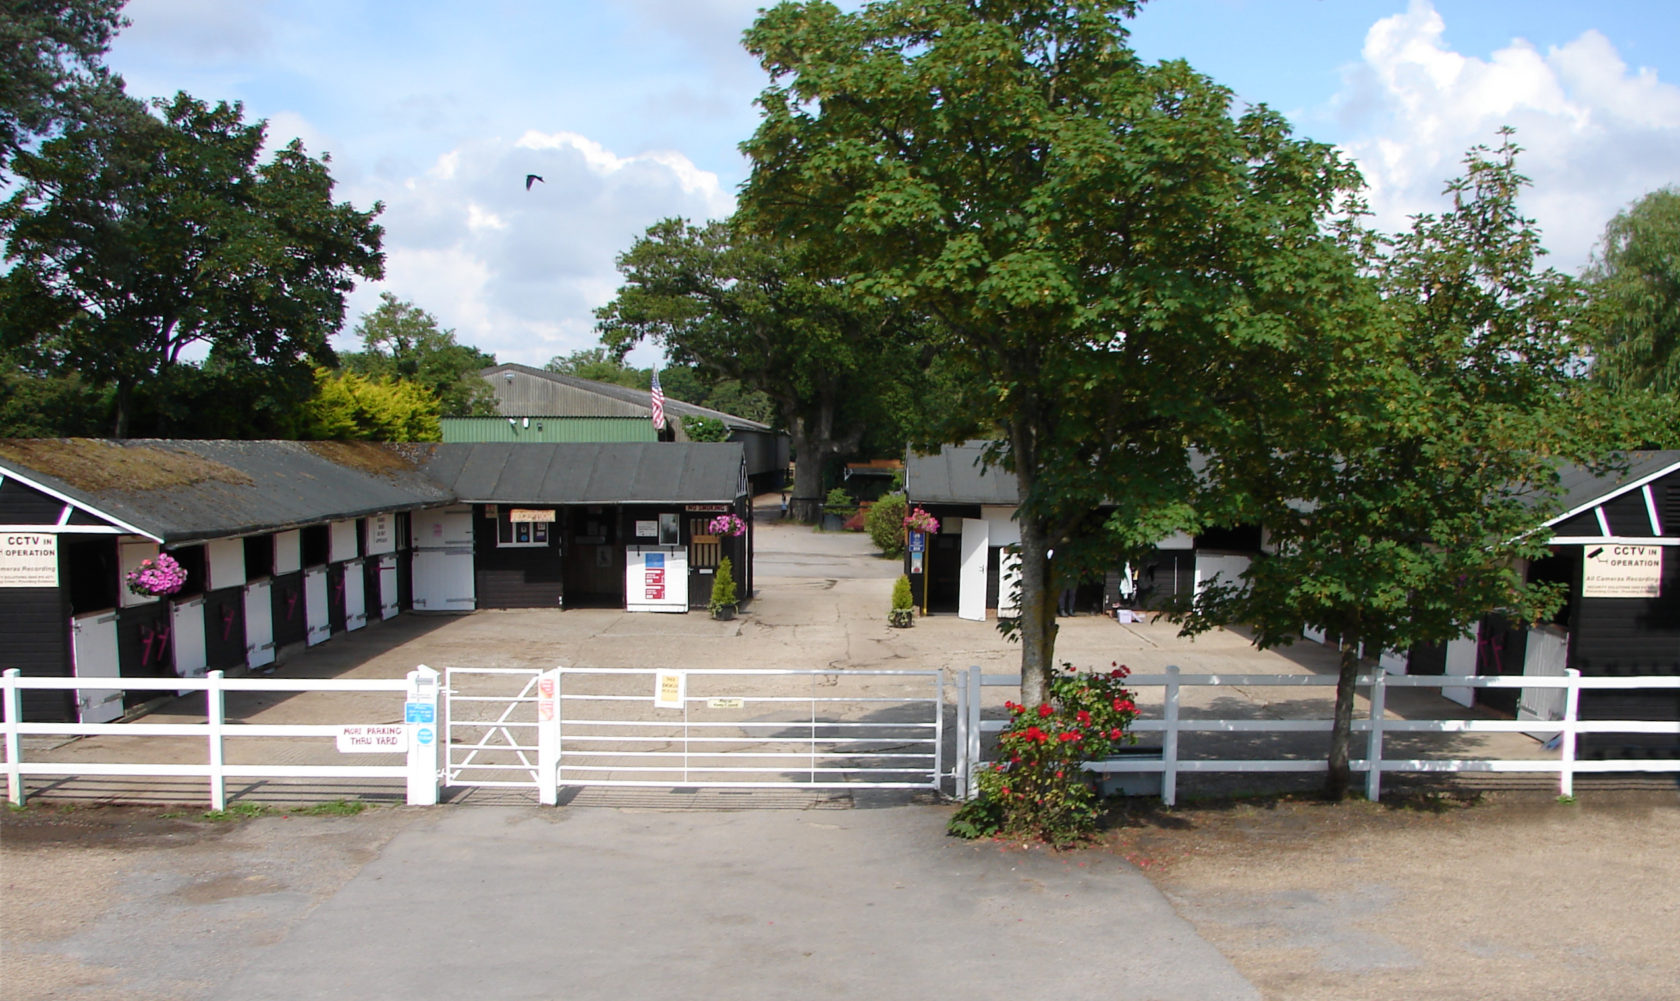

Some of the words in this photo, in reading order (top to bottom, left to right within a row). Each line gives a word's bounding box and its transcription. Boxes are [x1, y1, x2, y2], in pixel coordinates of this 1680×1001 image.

[8, 536, 40, 545] CCTV
[1614, 547, 1645, 555] CCTV
[367, 727, 402, 735] PARKING
[350, 737, 372, 745] THRU
[376, 737, 398, 745] YARD
